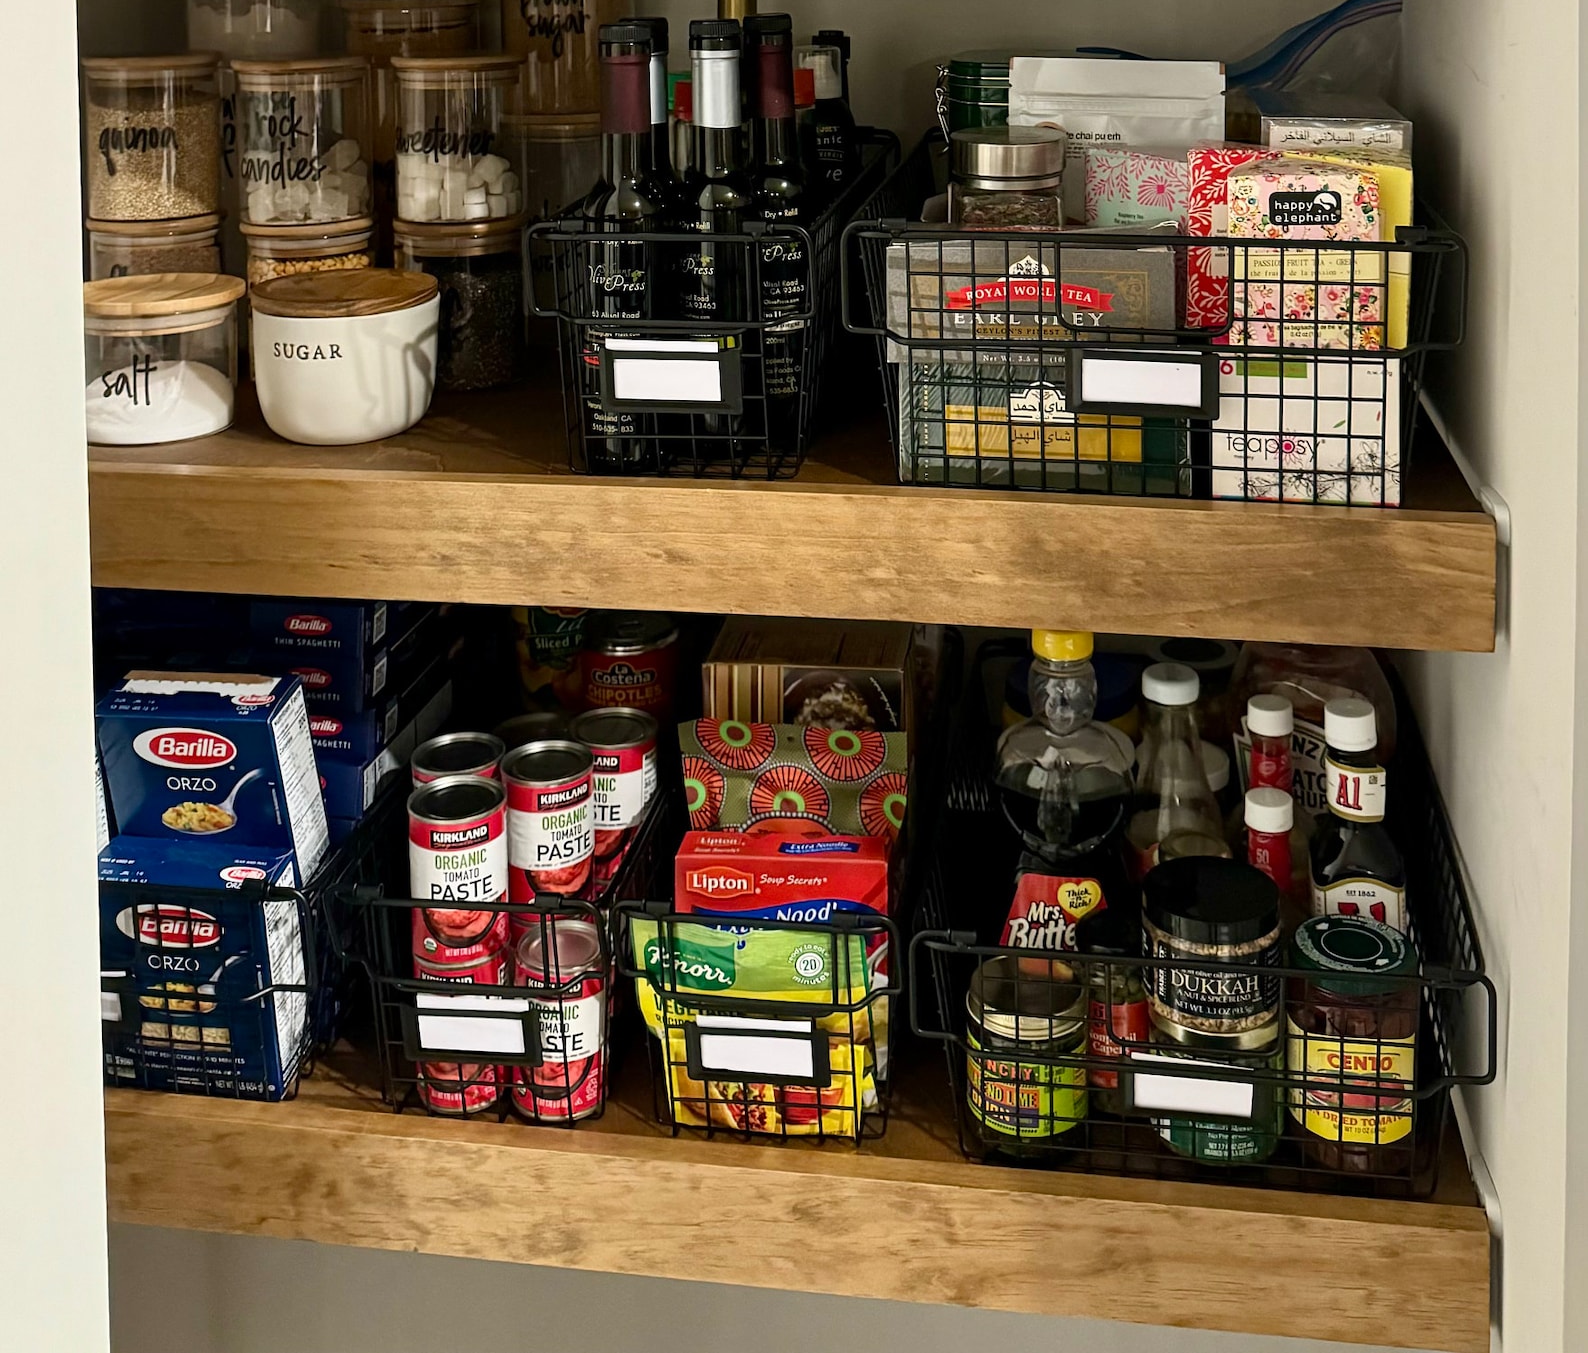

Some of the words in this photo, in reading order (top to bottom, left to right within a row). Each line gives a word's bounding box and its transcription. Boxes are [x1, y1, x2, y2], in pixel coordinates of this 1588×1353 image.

[525, 10, 591, 59] sugar
[255, 96, 309, 148] rock
[1075, 131, 1094, 140] chai
[1094, 132, 1106, 143] pu
[1107, 132, 1121, 141] erh
[1280, 128, 1311, 144] الفاخر
[1312, 130, 1355, 146] السيلاني
[1362, 130, 1393, 146] الشاي
[99, 117, 179, 177] quinoa
[240, 141, 328, 190] candies
[764, 210, 777, 219] Dry
[1274, 199, 1314, 215] happy
[1274, 210, 1338, 225] elephant
[1286, 258, 1309, 267] FRUIT
[1288, 268, 1298, 277] de
[1299, 268, 1309, 277] la
[770, 287, 781, 295] CA
[783, 285, 805, 294] 93463
[782, 278, 799, 287] Road
[693, 295, 710, 304] Road
[1067, 289, 1093, 303] TEA
[622, 310, 641, 319] Road
[694, 302, 717, 311] 93463
[954, 312, 1021, 326] EARL
[976, 327, 1023, 336] CEYLON'S
[765, 337, 786, 345] 200ml
[272, 342, 343, 360] SUGAR
[982, 354, 998, 363] Net
[1018, 355, 1032, 363] 3.5
[1220, 360, 1234, 375] 6
[101, 353, 158, 408] salt
[620, 413, 632, 423] CA
[1043, 429, 1072, 448] شاي
[1226, 432, 1321, 463] teaposy
[289, 618, 328, 632] Barilla
[274, 636, 294, 646] THIN
[296, 637, 342, 649] SPAGHETTI
[534, 635, 570, 650] Sliced
[614, 664, 629, 675] La
[587, 683, 663, 703] CHIPOTLES
[157, 737, 228, 758] Barilla
[166, 776, 218, 792] ORZO
[540, 783, 588, 805] KIRKLAND
[542, 804, 588, 831] ORGANIC
[433, 825, 488, 844] KIRKLAND
[551, 824, 582, 842] TOMATO
[537, 830, 592, 862] PASTE
[699, 836, 739, 847] Lipton
[435, 848, 487, 870] ORGANIC
[1256, 848, 1270, 864] 50
[443, 867, 480, 884] TOMATO
[692, 874, 748, 893] Lipton
[759, 873, 785, 886] Soup
[786, 874, 823, 886] Secrets
[430, 874, 493, 902] PASTE
[1065, 887, 1092, 898] Thick
[1358, 890, 1377, 898] 1862
[1069, 898, 1093, 910] Rich!
[1027, 901, 1064, 924] Mrs.
[787, 945, 803, 964] ready
[803, 943, 812, 951] to
[147, 954, 200, 972] ORZO
[647, 945, 733, 985] Knorr
[802, 959, 817, 972] 20
[791, 971, 831, 986] minutes
[1171, 969, 1259, 996] DUKKAH
[1183, 990, 1200, 1001] NUT
[1207, 995, 1228, 1003] SPICE
[1326, 1052, 1393, 1072] CENTO
